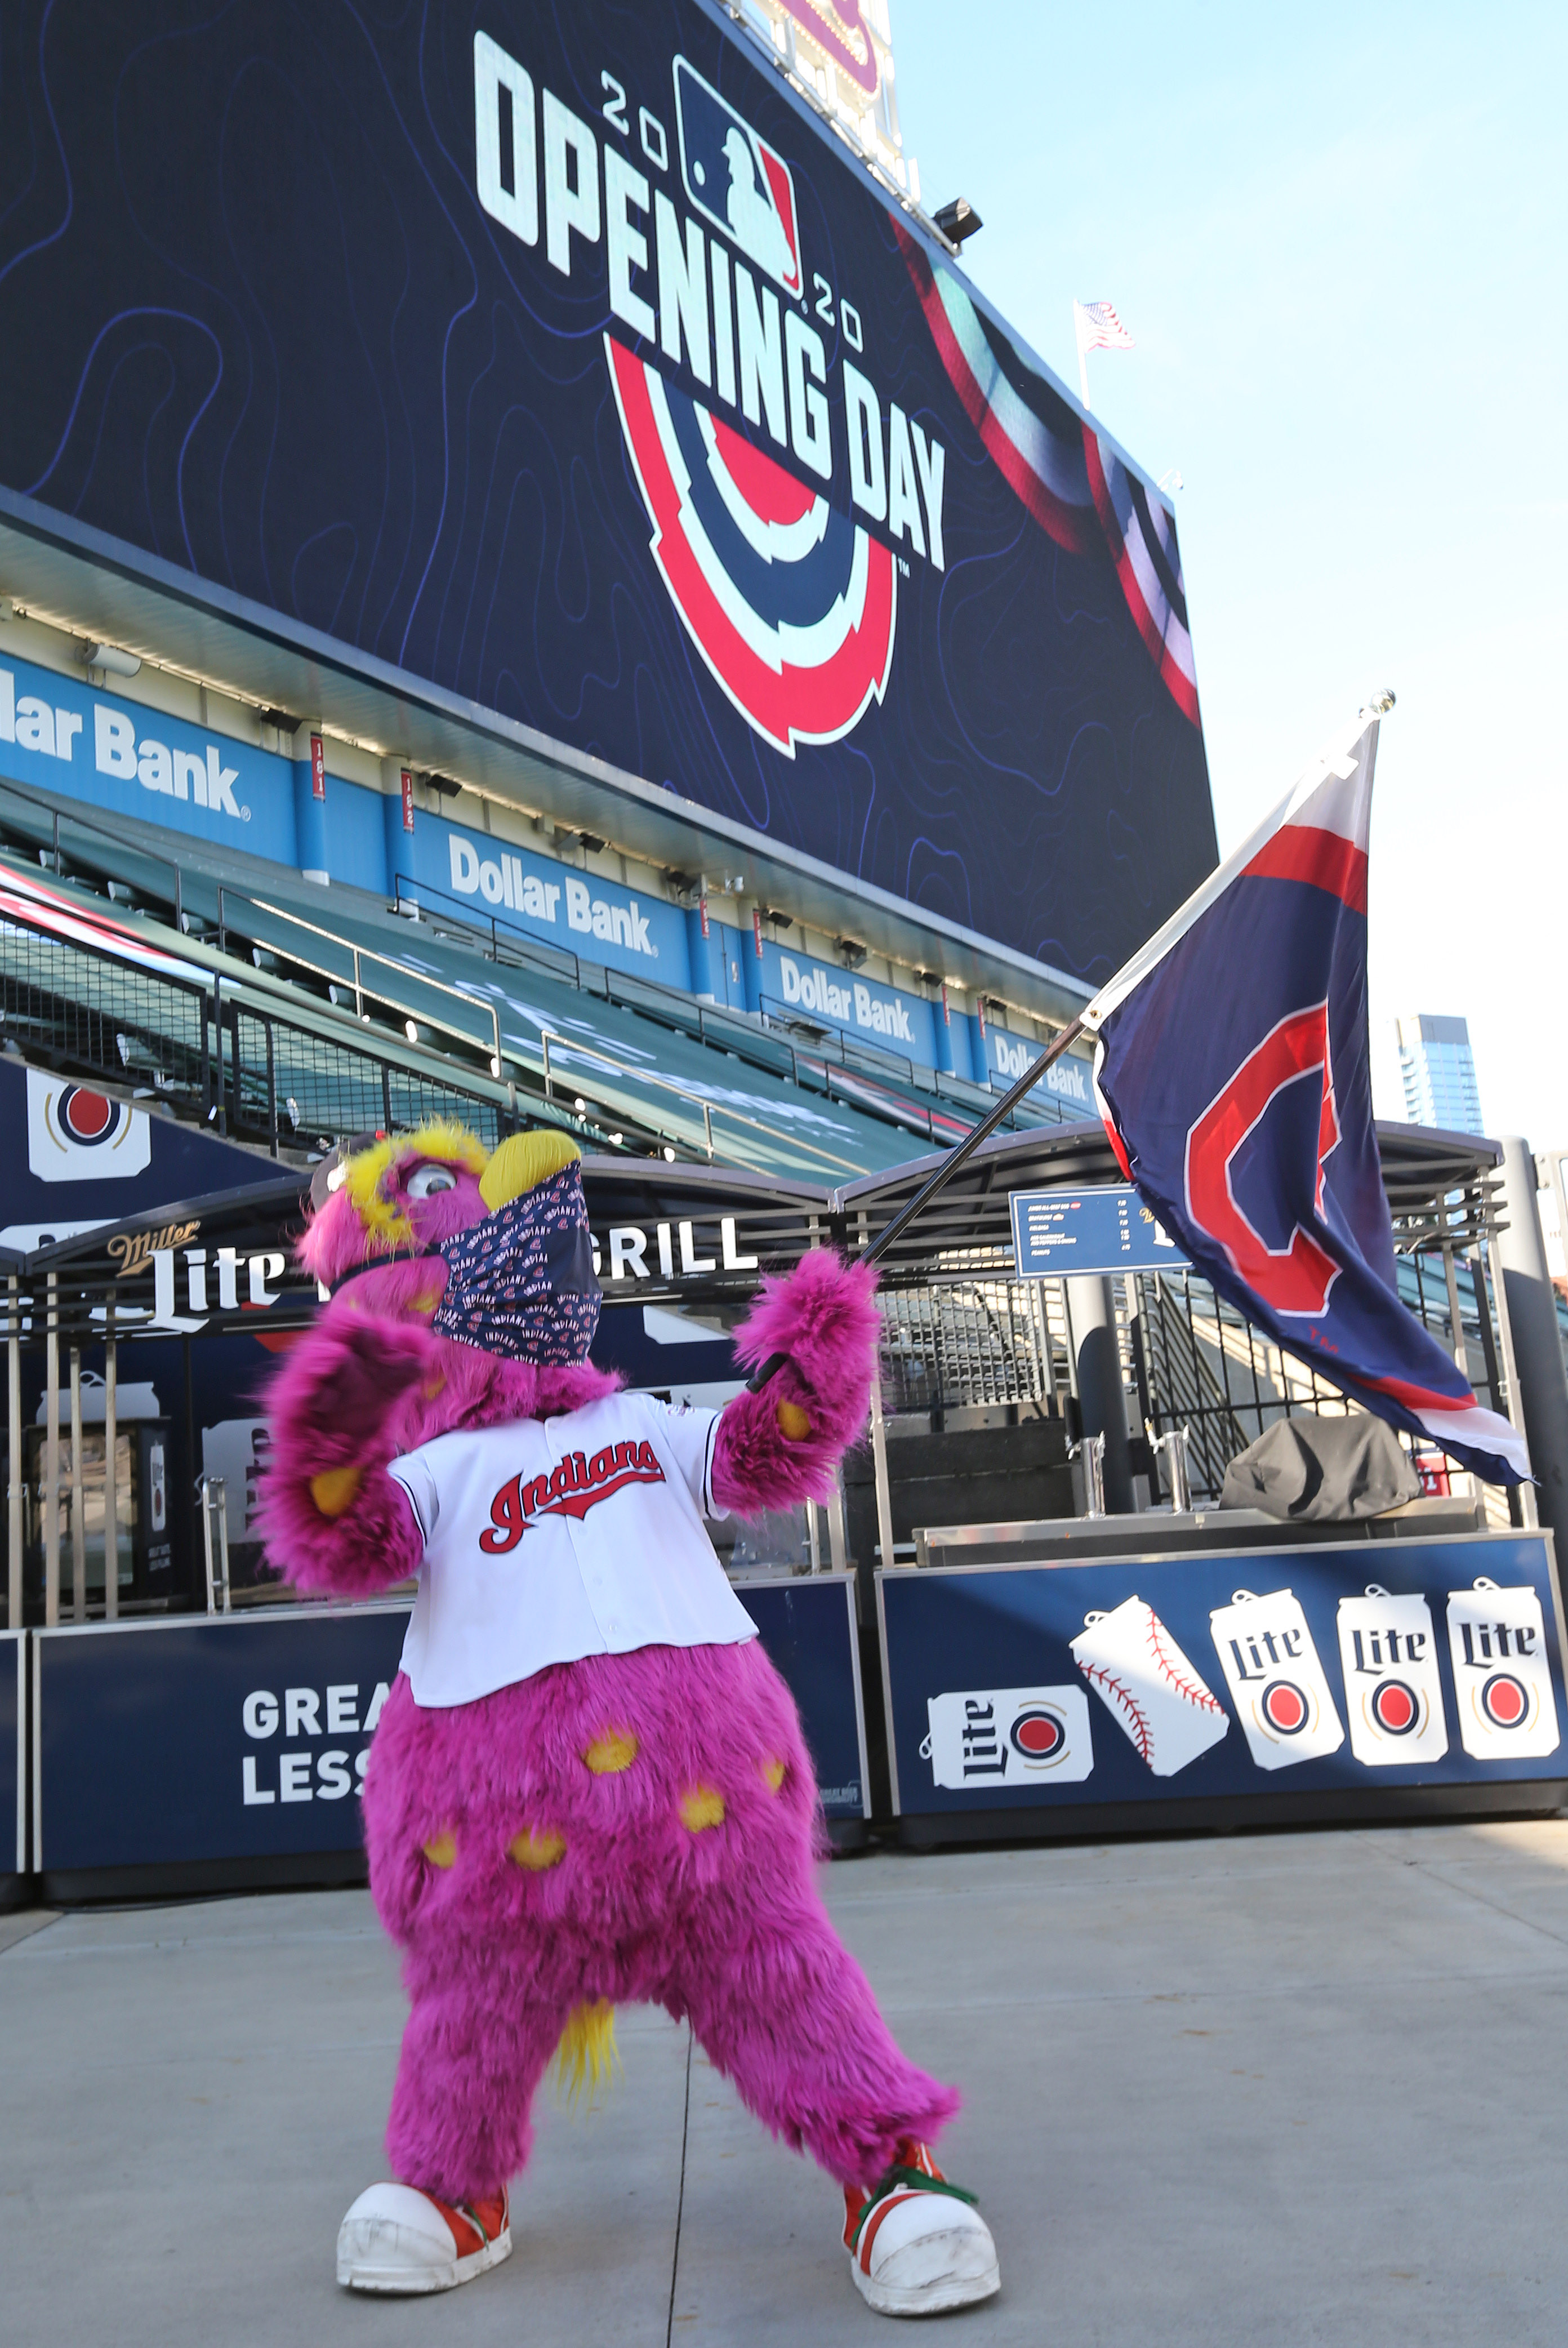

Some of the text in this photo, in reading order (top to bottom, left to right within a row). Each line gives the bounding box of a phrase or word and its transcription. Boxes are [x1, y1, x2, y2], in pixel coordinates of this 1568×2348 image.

[600, 69, 863, 353] 20 20
[473, 29, 945, 573] OPENING DAY
[94, 703, 241, 818] Bank
[449, 834, 653, 956] Dollar Bank
[781, 956, 852, 1022] Dollar
[853, 982, 913, 1042] Bank
[1046, 1062, 1088, 1101] Bank
[107, 1220, 201, 1273] Miller
[146, 1247, 286, 1333] Lite
[479, 1440, 663, 1554] Indians
[1227, 1629, 1303, 1680] Lite
[1351, 1629, 1426, 1675] Lite
[1456, 1622, 1536, 1669] Lite
[963, 1700, 1008, 1781] Lite
